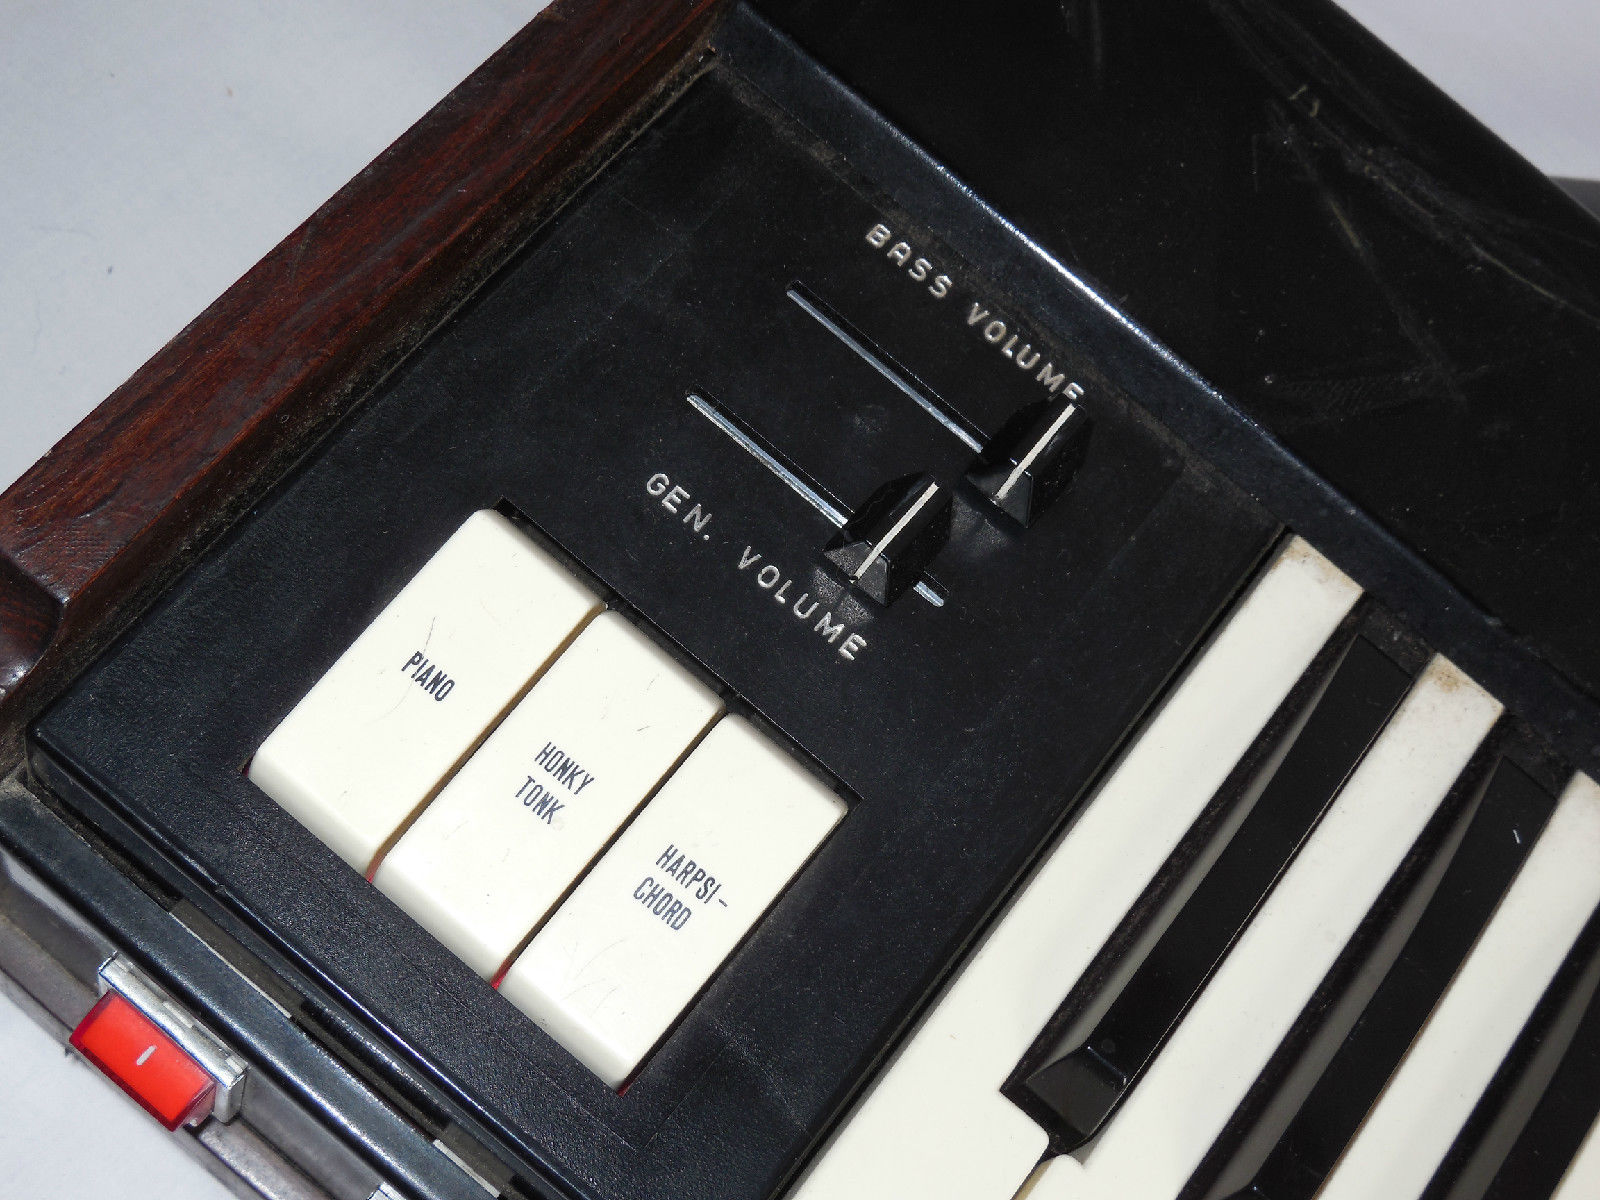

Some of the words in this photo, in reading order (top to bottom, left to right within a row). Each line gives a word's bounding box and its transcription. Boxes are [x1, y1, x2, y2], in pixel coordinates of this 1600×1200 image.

[866, 223, 953, 299] BASS
[645, 473, 711, 541] GEN.
[736, 545, 868, 660] VOLUME
[401, 650, 456, 702] PIANO
[534, 742, 595, 795] HONKY
[515, 775, 565, 825] TONK
[655, 844, 728, 907] HARPSI-
[633, 877, 692, 931] CHORD
